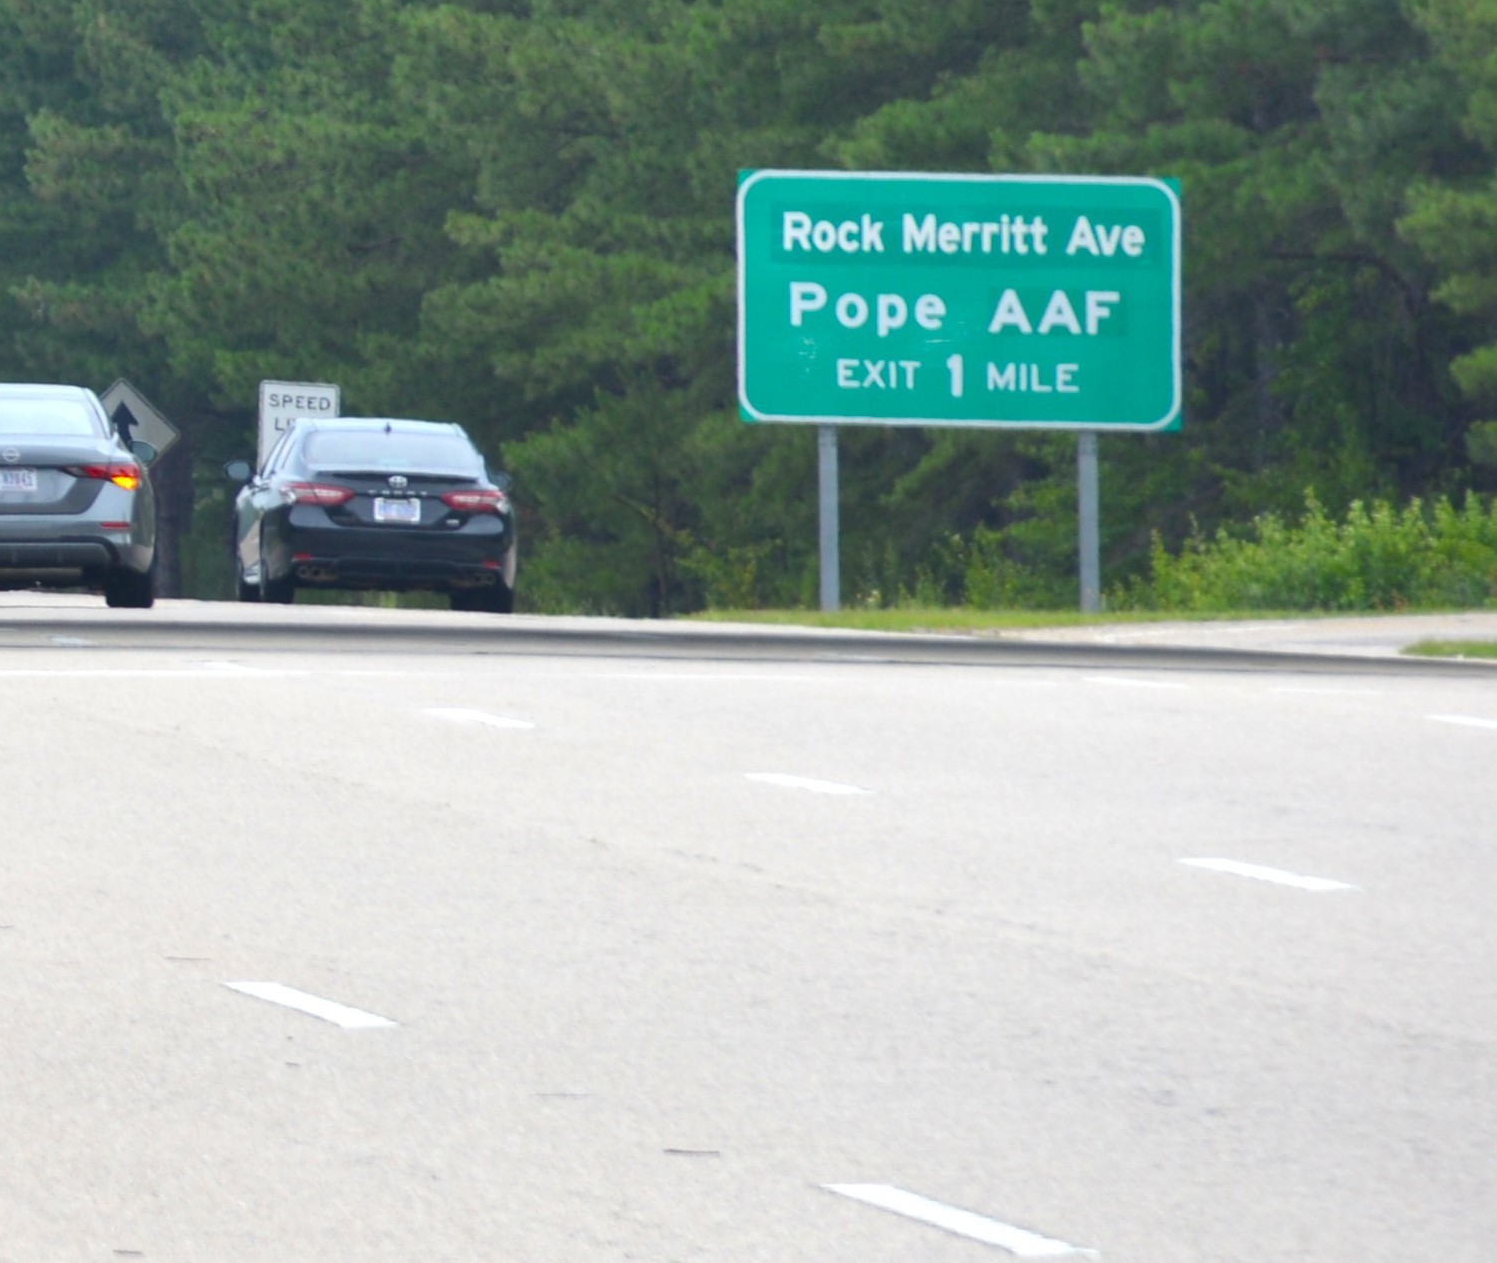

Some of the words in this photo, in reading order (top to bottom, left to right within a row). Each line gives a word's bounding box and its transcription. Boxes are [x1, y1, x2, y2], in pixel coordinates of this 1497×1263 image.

[782, 211, 885, 253] Rock
[902, 213, 1048, 255] Merritt
[1065, 215, 1146, 257] Ave
[789, 281, 947, 338] Pope
[988, 289, 1120, 336] AAF
[836, 358, 921, 390] EXIT
[946, 353, 964, 398] 1
[987, 362, 1081, 393] MILE
[269, 393, 332, 411] SPEED
